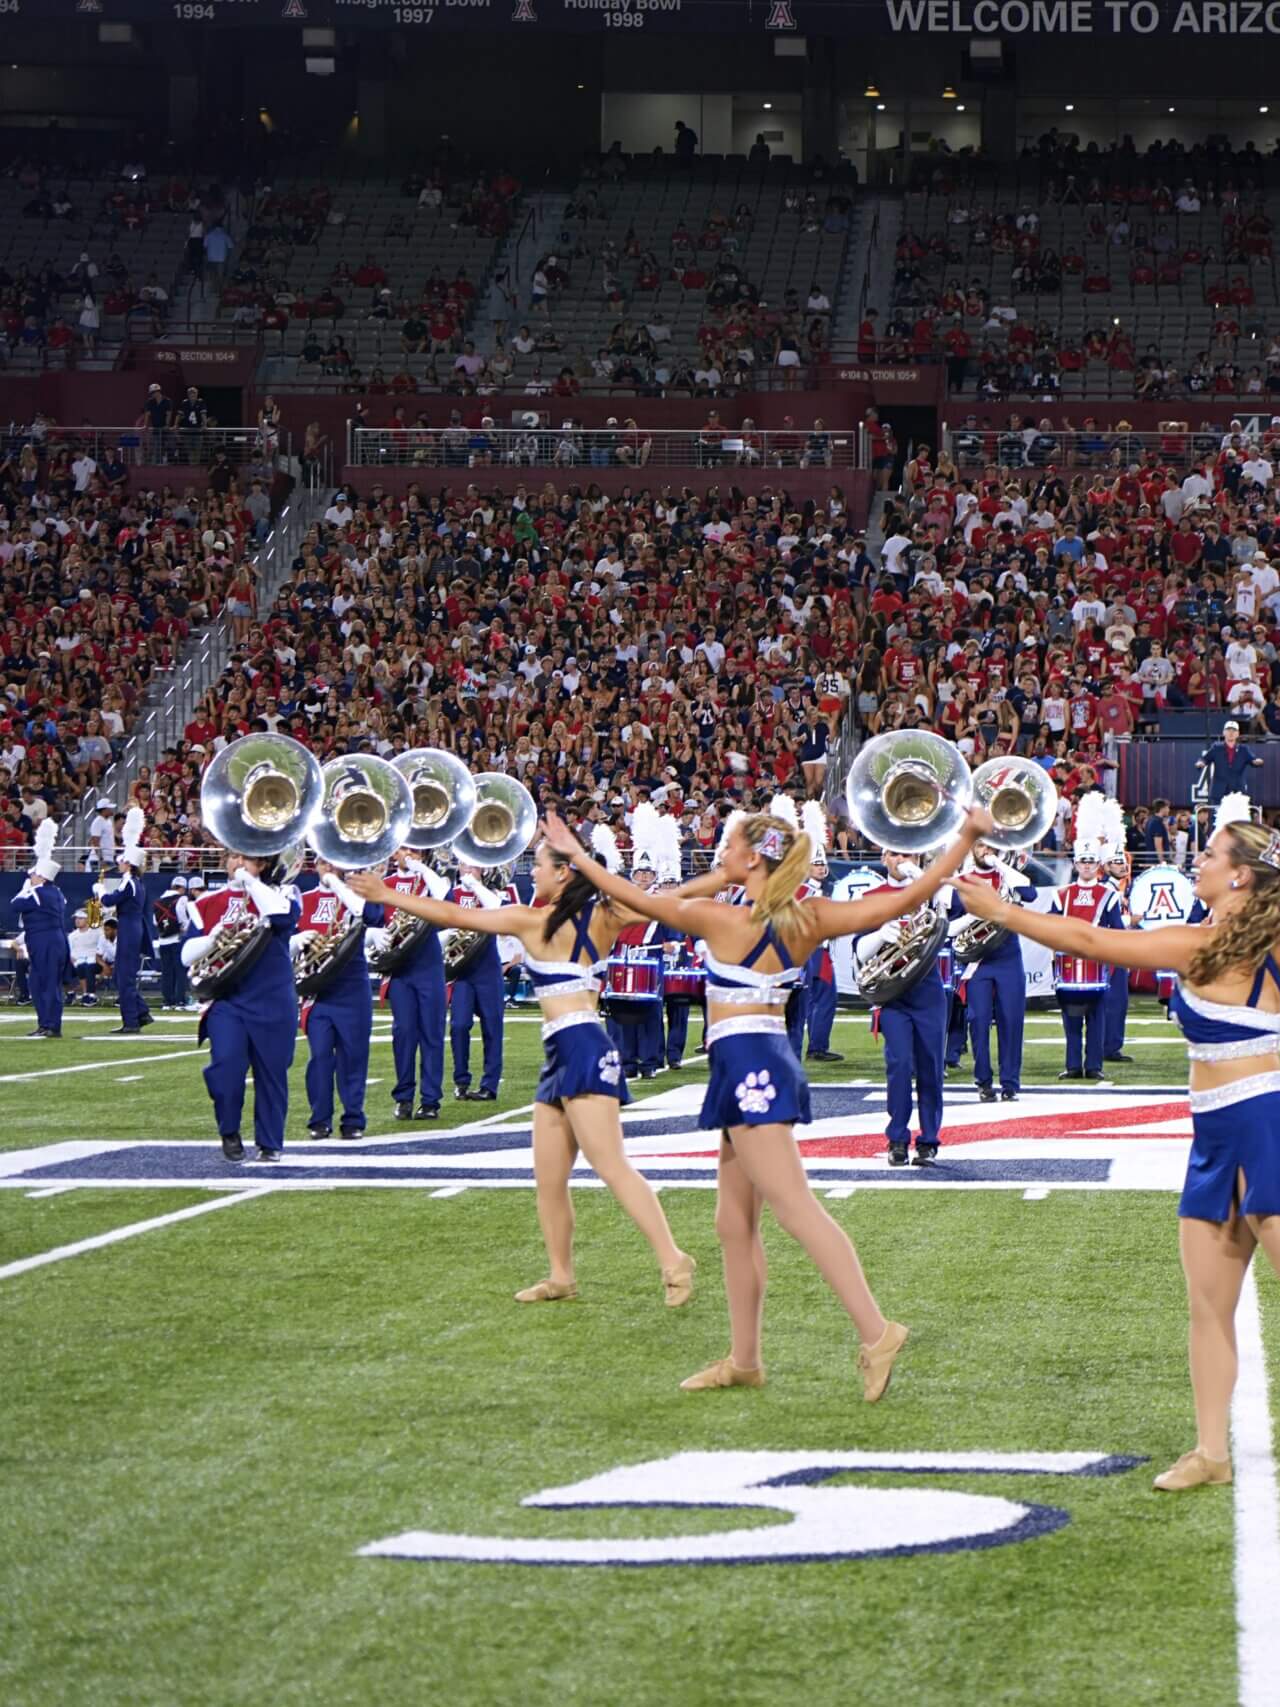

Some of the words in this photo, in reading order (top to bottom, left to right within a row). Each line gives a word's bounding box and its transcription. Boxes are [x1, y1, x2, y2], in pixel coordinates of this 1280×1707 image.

[173, 4, 215, 19] 1994
[564, 0, 630, 13] Holiday
[635, 0, 681, 11] Bowl
[393, 8, 433, 23] 1997
[602, 12, 644, 27] 1998
[886, 0, 1093, 32] WELCOME
[1104, 1, 1160, 33] TO
[180, 352, 213, 361] SECTION
[863, 370, 895, 381] SCTION
[1143, 882, 1184, 920] A
[310, 896, 337, 924] A
